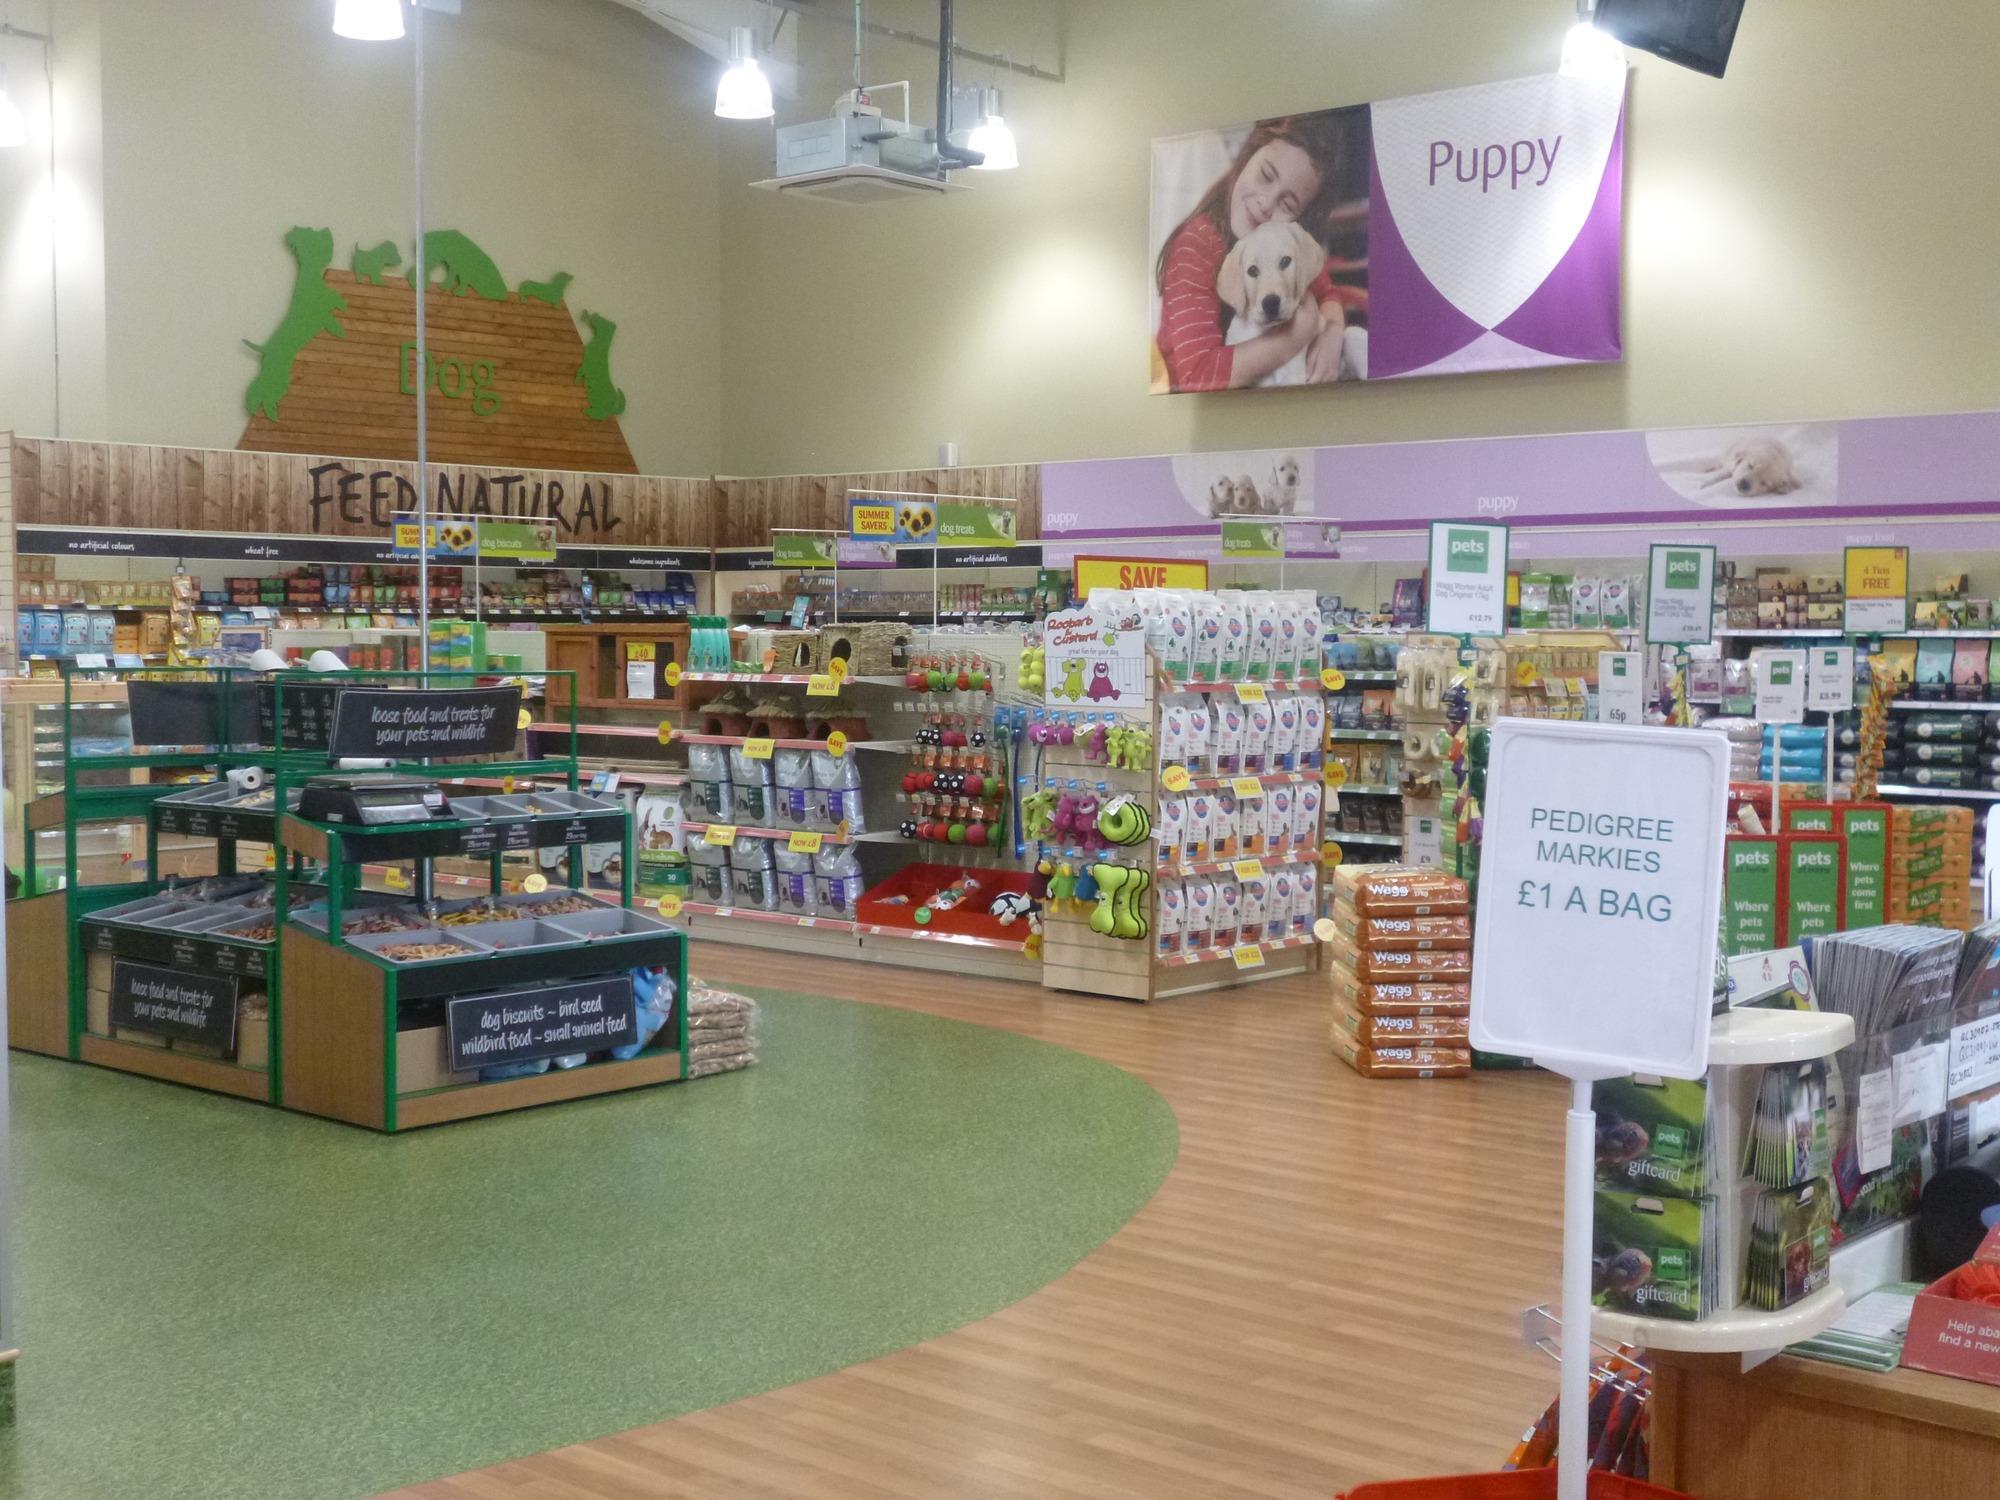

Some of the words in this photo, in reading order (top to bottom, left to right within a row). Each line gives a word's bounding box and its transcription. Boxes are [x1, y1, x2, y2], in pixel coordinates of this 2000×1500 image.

[1430, 136, 1562, 193] Puppy
[401, 341, 501, 416] Dog
[309, 462, 417, 532] FEED
[437, 473, 621, 535] NATURAL
[1478, 495, 1519, 514] puppy
[858, 510, 890, 520] SUMMER
[1047, 512, 1078, 526] puppy
[861, 521, 888, 530] SAVERS
[940, 522, 955, 536] dog
[956, 523, 975, 535] treats
[80, 540, 110, 552] artificial
[112, 542, 135, 552] colours
[266, 546, 279, 558] free
[1451, 539, 1485, 554] pets
[1669, 560, 1697, 574] pets
[1120, 564, 1168, 589] SAVE
[1863, 578, 1891, 589] FREE
[371, 706, 400, 723] loose
[403, 706, 428, 725] food
[429, 706, 450, 722] and
[451, 705, 479, 721] treats
[481, 704, 496, 721] for
[1610, 708, 1626, 723] 65p
[376, 729, 404, 746] your
[405, 726, 429, 746] pets
[431, 725, 451, 740] and
[451, 723, 486, 740] wildlife
[1167, 771, 1186, 785] SAVE
[1531, 808, 1674, 842] PEDIGREE
[1797, 819, 1826, 831] pets
[1850, 819, 1879, 833] pets
[1537, 840, 1661, 873] MARKIES
[1735, 851, 1769, 867] pets
[1797, 852, 1832, 867] pets
[1850, 862, 1879, 872] Where
[1854, 876, 1873, 886] pets
[1369, 884, 1409, 897] Wagg
[1852, 889, 1876, 897] come
[1518, 880, 1551, 909] £1
[1564, 886, 1587, 913] A
[1599, 889, 1672, 922] BAG
[1734, 900, 1769, 912] Where
[1796, 901, 1831, 912] Where
[1854, 900, 1873, 910] first
[1373, 919, 1411, 931] Wagg
[1740, 918, 1762, 929] pets
[1802, 918, 1824, 929] pets
[1736, 933, 1765, 941] come
[1375, 951, 1412, 964] Wagg
[131, 978, 148, 996] loose
[149, 981, 165, 999] food
[165, 985, 179, 1001] and
[180, 987, 200, 1006] treats
[202, 990, 214, 1009] for
[1375, 984, 1412, 996] Wagg
[134, 1002, 150, 1018] your
[151, 1002, 166, 1020] pets
[166, 1005, 181, 1022] and
[481, 1010, 500, 1031] dog
[503, 1005, 544, 1026] biscuits
[559, 998, 579, 1017] bird
[581, 995, 603, 1013] seed
[1375, 1016, 1413, 1029] Wagg
[462, 1035, 507, 1056] wildbird
[508, 1028, 532, 1050] food
[544, 1022, 570, 1043] small
[573, 1017, 604, 1038] animal
[606, 1013, 627, 1035] feed
[1377, 1048, 1412, 1059] Wagg
[1658, 1132, 1681, 1144] pets
[1628, 1160, 1681, 1182] giftcard
[1659, 1255, 1684, 1265] pets
[1636, 1286, 1688, 1304] giftcard
[1947, 1319, 1975, 1334] Help
[1938, 1332, 1961, 1346] find
[1963, 1339, 1972, 1348] a
[1975, 1341, 2000, 1353] new
